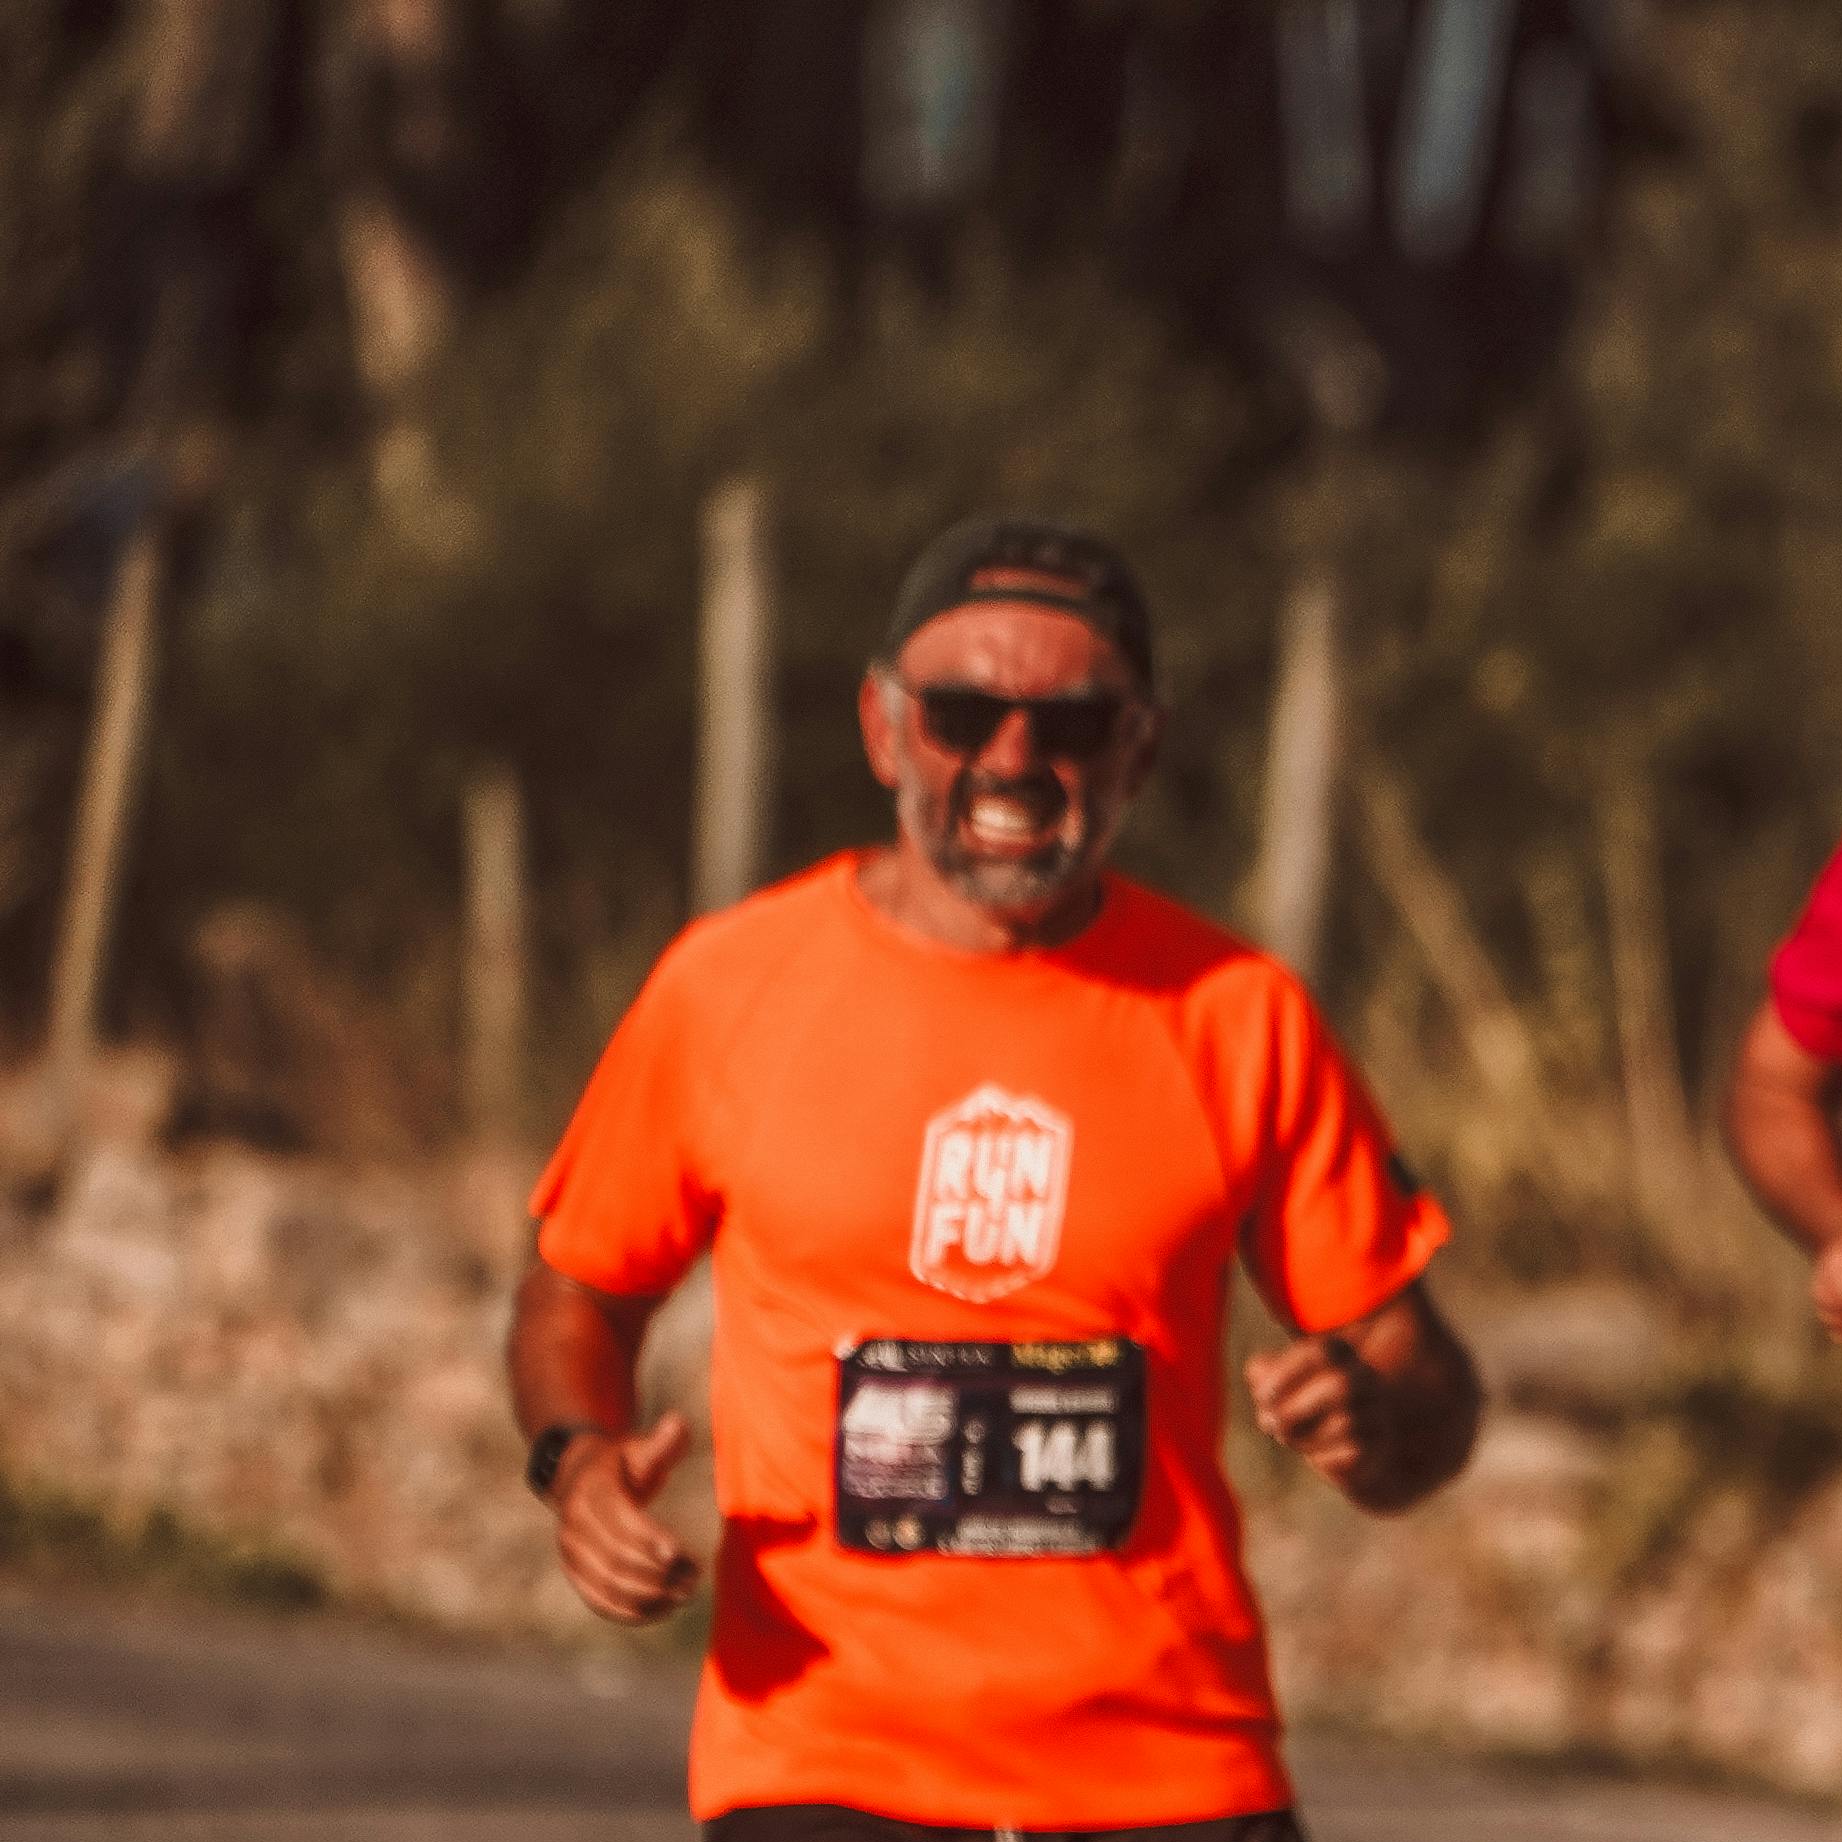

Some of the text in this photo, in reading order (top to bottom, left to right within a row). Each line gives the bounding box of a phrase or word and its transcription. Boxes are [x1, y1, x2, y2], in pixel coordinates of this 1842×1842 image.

[935, 1132, 1051, 1200] RUN
[925, 1203, 1044, 1266] FUN
[1011, 1421, 1117, 1492] 144
